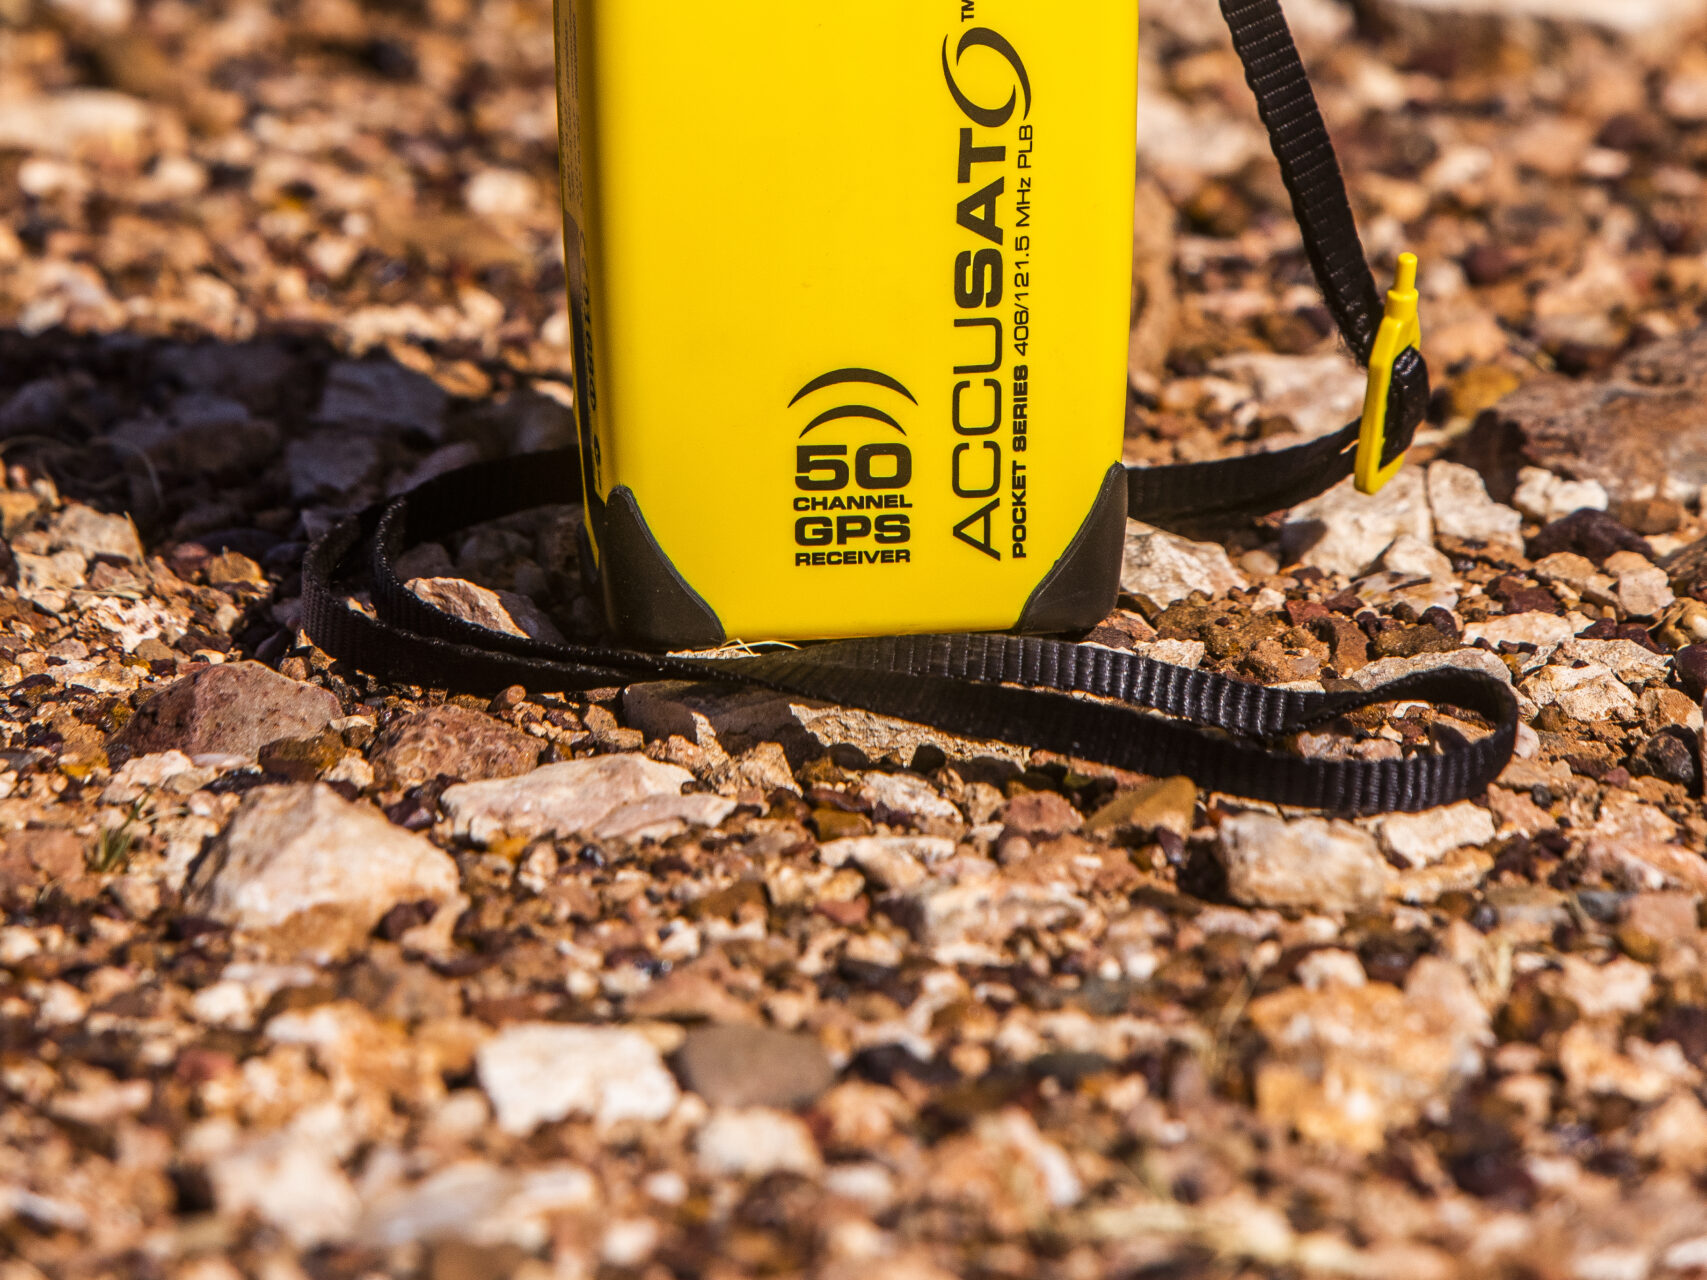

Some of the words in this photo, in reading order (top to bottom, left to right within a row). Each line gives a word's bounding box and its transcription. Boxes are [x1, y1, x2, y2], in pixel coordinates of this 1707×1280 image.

[1017, 123, 1034, 169] PLB
[1015, 176, 1032, 228] MHz
[1013, 234, 1031, 357] 406/121.5
[1012, 364, 1029, 453] SERIES
[794, 442, 912, 492] 50
[792, 494, 913, 512] CHANNEL
[1012, 459, 1028, 559] POCKET
[794, 513, 911, 547] GPS
[795, 549, 911, 567] RECEIVER
